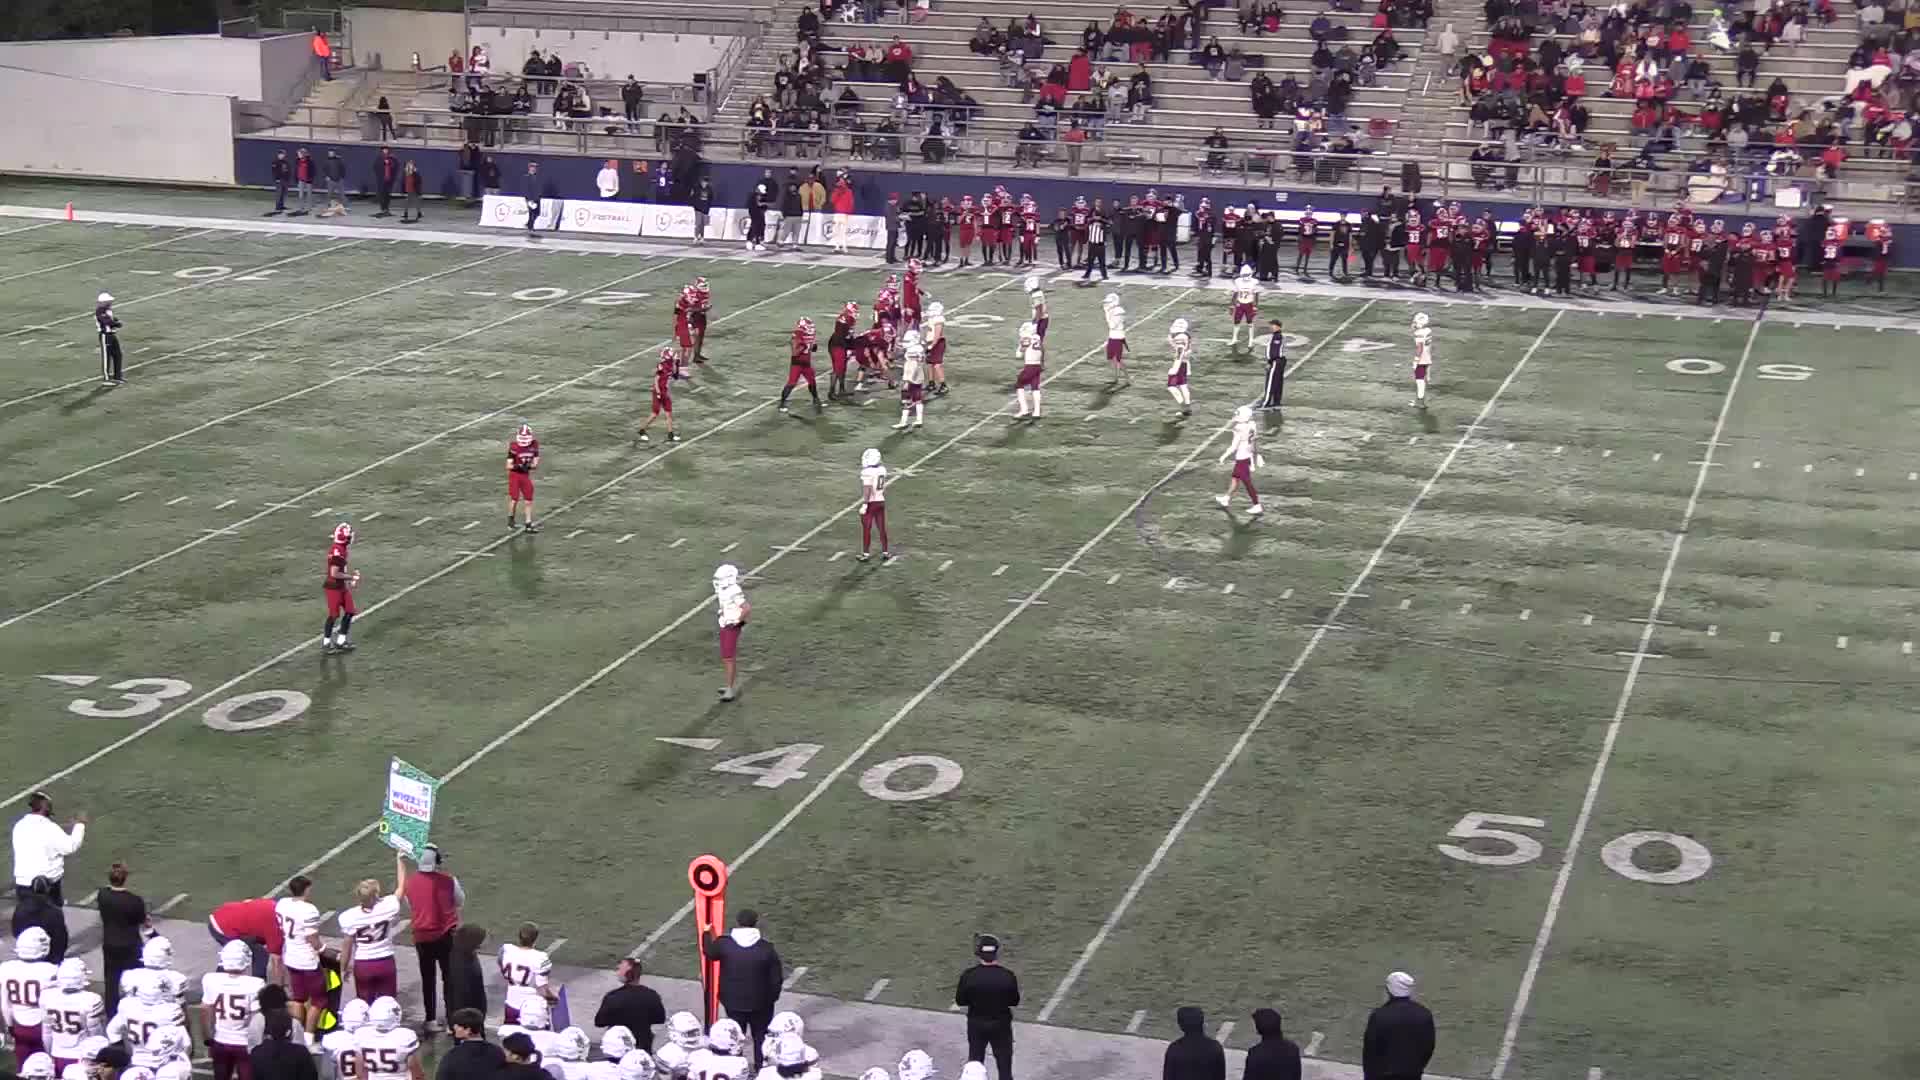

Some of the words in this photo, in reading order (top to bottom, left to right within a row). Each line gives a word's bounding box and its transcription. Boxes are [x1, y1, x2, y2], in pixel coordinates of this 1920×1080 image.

[356, 919, 390, 945] 57
[502, 961, 530, 988] 47
[6, 978, 41, 1008] 80
[213, 992, 247, 1021] 45
[47, 1009, 82, 1035] 35
[360, 1047, 399, 1073] 55
